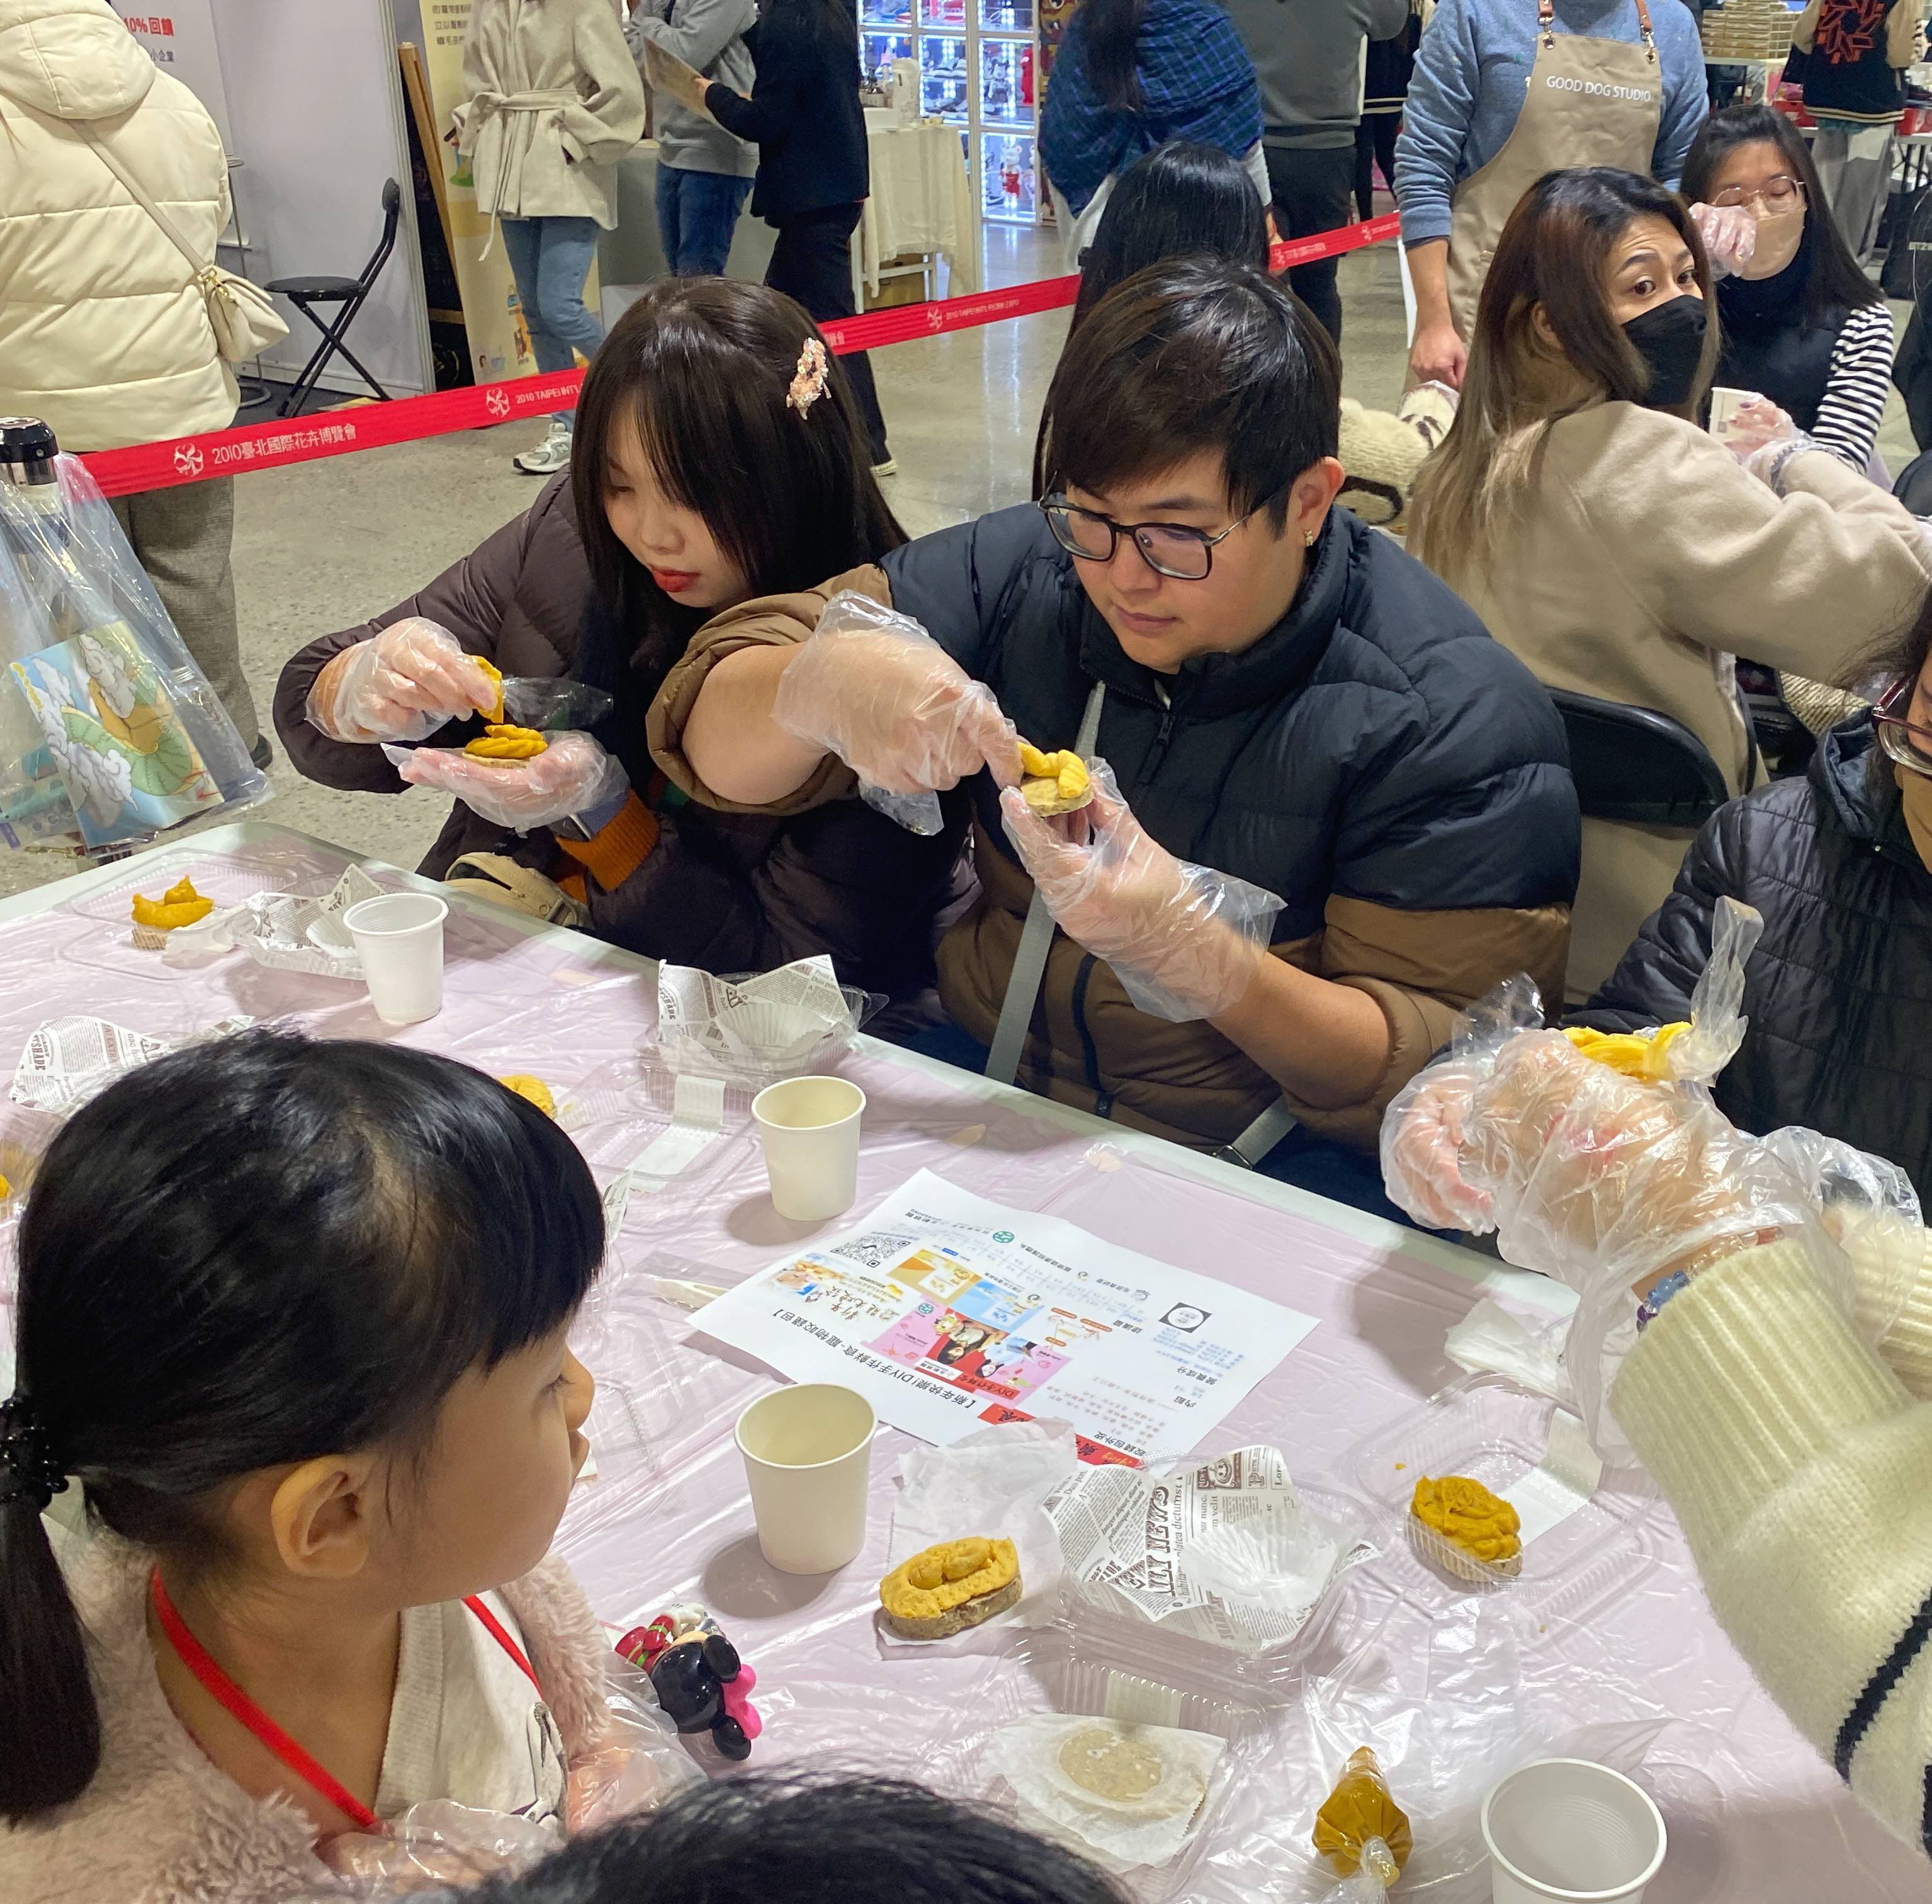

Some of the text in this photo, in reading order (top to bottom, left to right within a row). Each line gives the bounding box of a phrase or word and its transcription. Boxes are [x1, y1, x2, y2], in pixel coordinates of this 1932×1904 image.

[1547, 76, 1651, 102] GOOD DOG STUDIO
[516, 392, 535, 404] 2010
[534, 388, 562, 400] TAIPEI
[212, 423, 357, 465] 2010臺北國際花卉博覽會
[1145, 1485, 1170, 1553] NEWS
[1171, 1483, 1183, 1529] dictumst
[1210, 1495, 1219, 1516] velit
